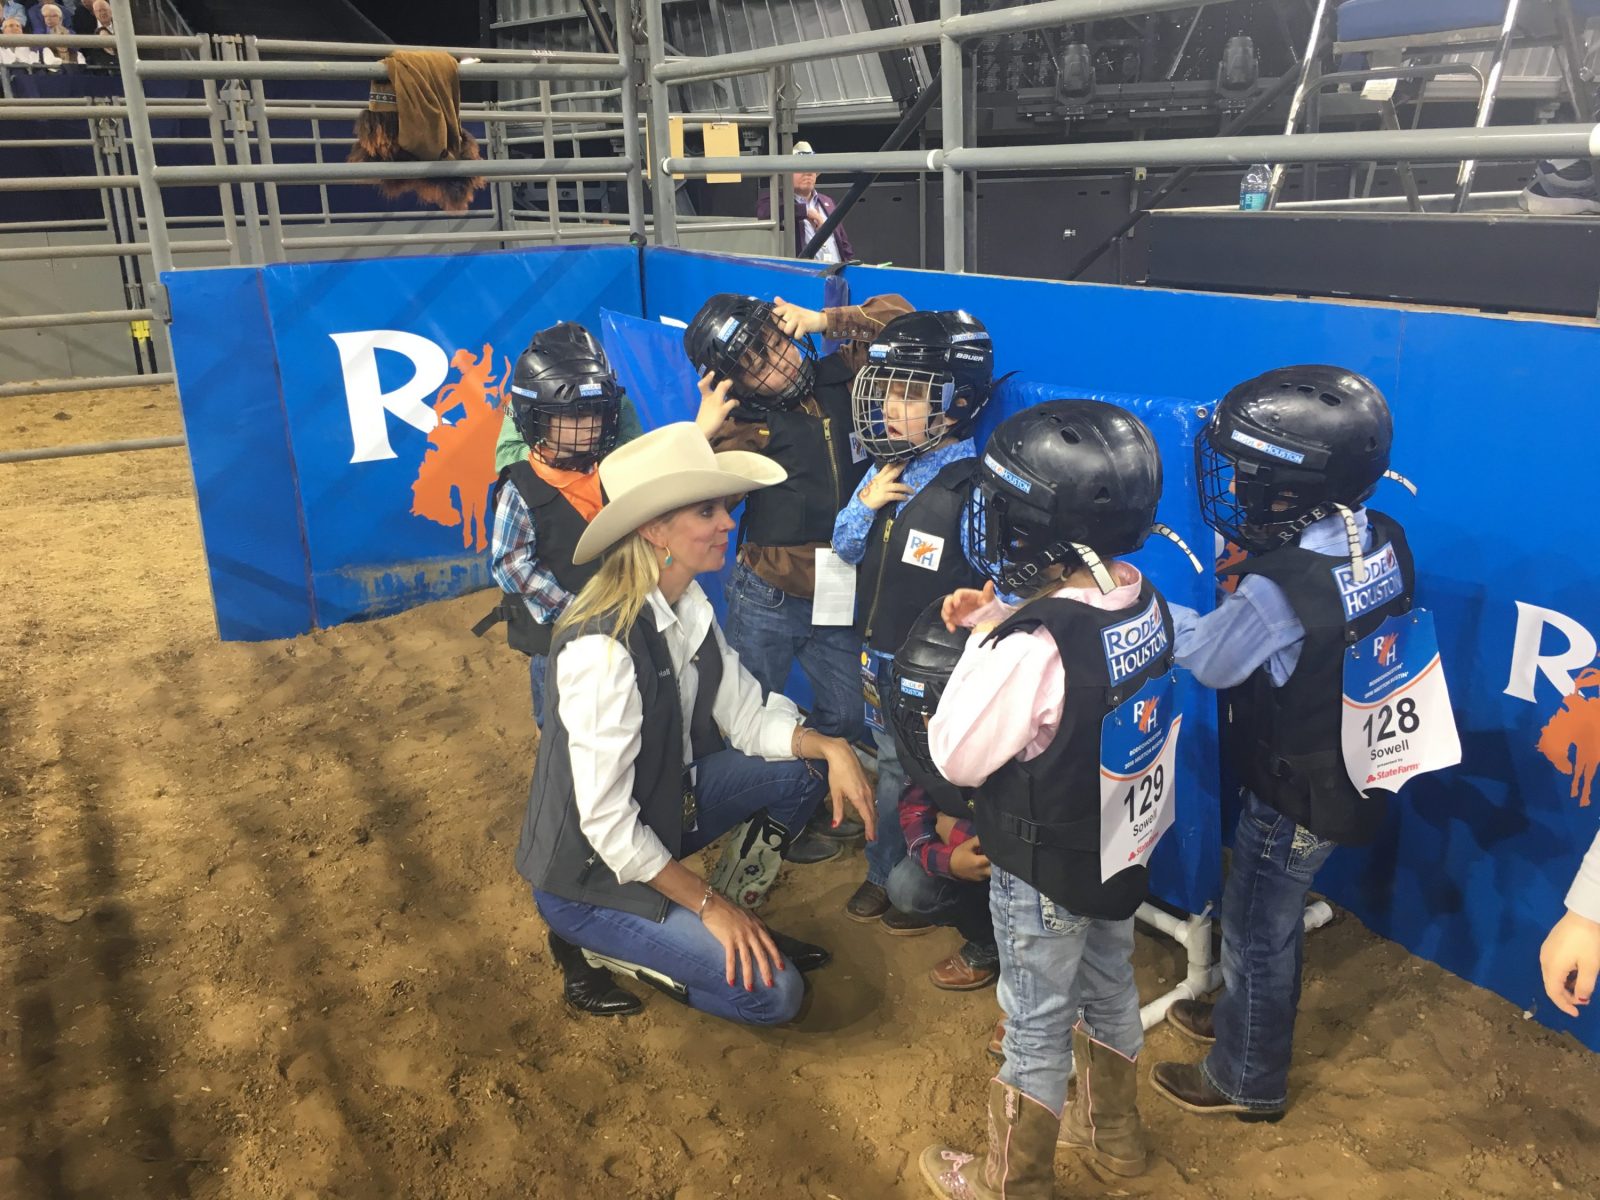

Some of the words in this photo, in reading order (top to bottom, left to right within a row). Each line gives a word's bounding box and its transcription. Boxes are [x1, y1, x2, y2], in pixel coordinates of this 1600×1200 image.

[328, 330, 452, 464] R
[1264, 444, 1303, 464] HOUSTON
[1110, 627, 1168, 681] HOUSTON
[1503, 600, 1597, 704] R
[1363, 697, 1420, 748] 128
[1370, 739, 1409, 761] Sowell
[1124, 764, 1164, 823] 129
